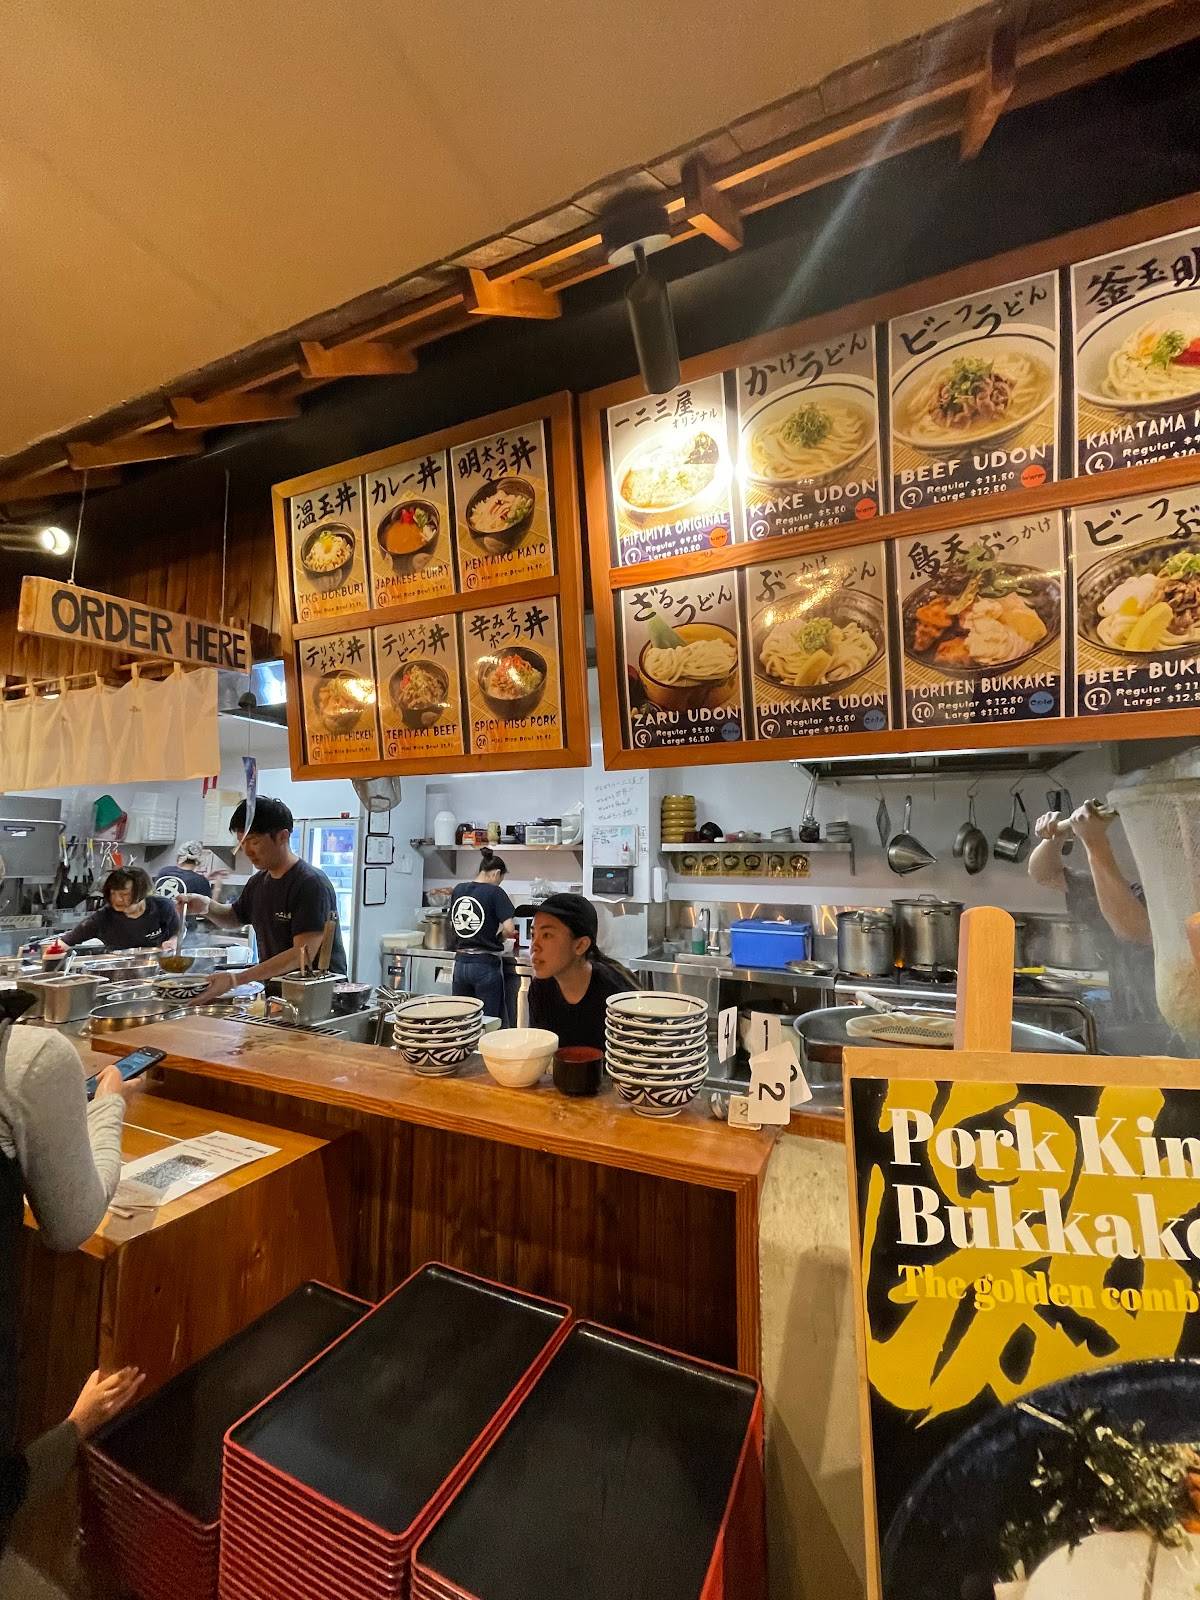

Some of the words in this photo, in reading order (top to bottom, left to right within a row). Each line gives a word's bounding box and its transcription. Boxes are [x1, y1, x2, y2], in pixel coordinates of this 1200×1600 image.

[900, 285, 1047, 355] ビーフうどん
[744, 332, 867, 397] かけうどん
[614, 389, 694, 428] 一二三屋
[672, 407, 718, 430] オリジナル
[1086, 413, 1187, 450] KAMATAMA
[1122, 440, 1177, 458] Regular
[900, 459, 961, 485] BEEF
[973, 443, 1046, 471] UDON
[371, 455, 442, 506] カレー丼
[926, 481, 971, 495] Regular
[976, 471, 1015, 485] $11.80
[749, 492, 805, 518] KAKE
[814, 477, 877, 504] UDON
[933, 491, 966, 504] Large
[970, 483, 1007, 497] $12.80
[296, 481, 357, 530] 温玉丼
[775, 512, 813, 526] Regular
[781, 523, 810, 535] Large
[622, 523, 672, 548] HIFUMIYA
[675, 512, 728, 535] ORIGINAL
[517, 542, 546, 559] MAYO
[645, 540, 676, 554] Regular
[376, 572, 417, 590] JAPANESE
[629, 584, 733, 625] ざるうどん
[51, 590, 173, 654] ORDER
[185, 621, 246, 669] HERE
[911, 679, 975, 699] TORITEN
[981, 671, 1056, 694] BUKKAKE
[1084, 664, 1138, 685] BEEF
[1116, 685, 1167, 697] Regular
[1123, 696, 1161, 707] Large
[760, 695, 832, 717] BUKKAKE
[838, 691, 885, 710] UDON
[938, 700, 980, 711] Regular
[985, 695, 1024, 706] $12.80
[474, 719, 500, 732] SPICY
[504, 718, 527, 729] MISO
[530, 714, 557, 728] PORK
[633, 710, 680, 728] ZARU
[687, 704, 739, 723] UDON
[786, 717, 823, 728] Regular
[945, 711, 976, 720] Large
[386, 727, 429, 740] TERIYAKI
[433, 724, 457, 737] BEEF
[655, 728, 688, 738] Regular
[661, 737, 685, 746] Large
[792, 727, 820, 737] Large
[758, 1082, 786, 1101] 2
[888, 1108, 1065, 1173] Pork
[1074, 1115, 1200, 1179] Kin
[898, 1264, 967, 1300] The
[974, 1269, 1094, 1312] golden
